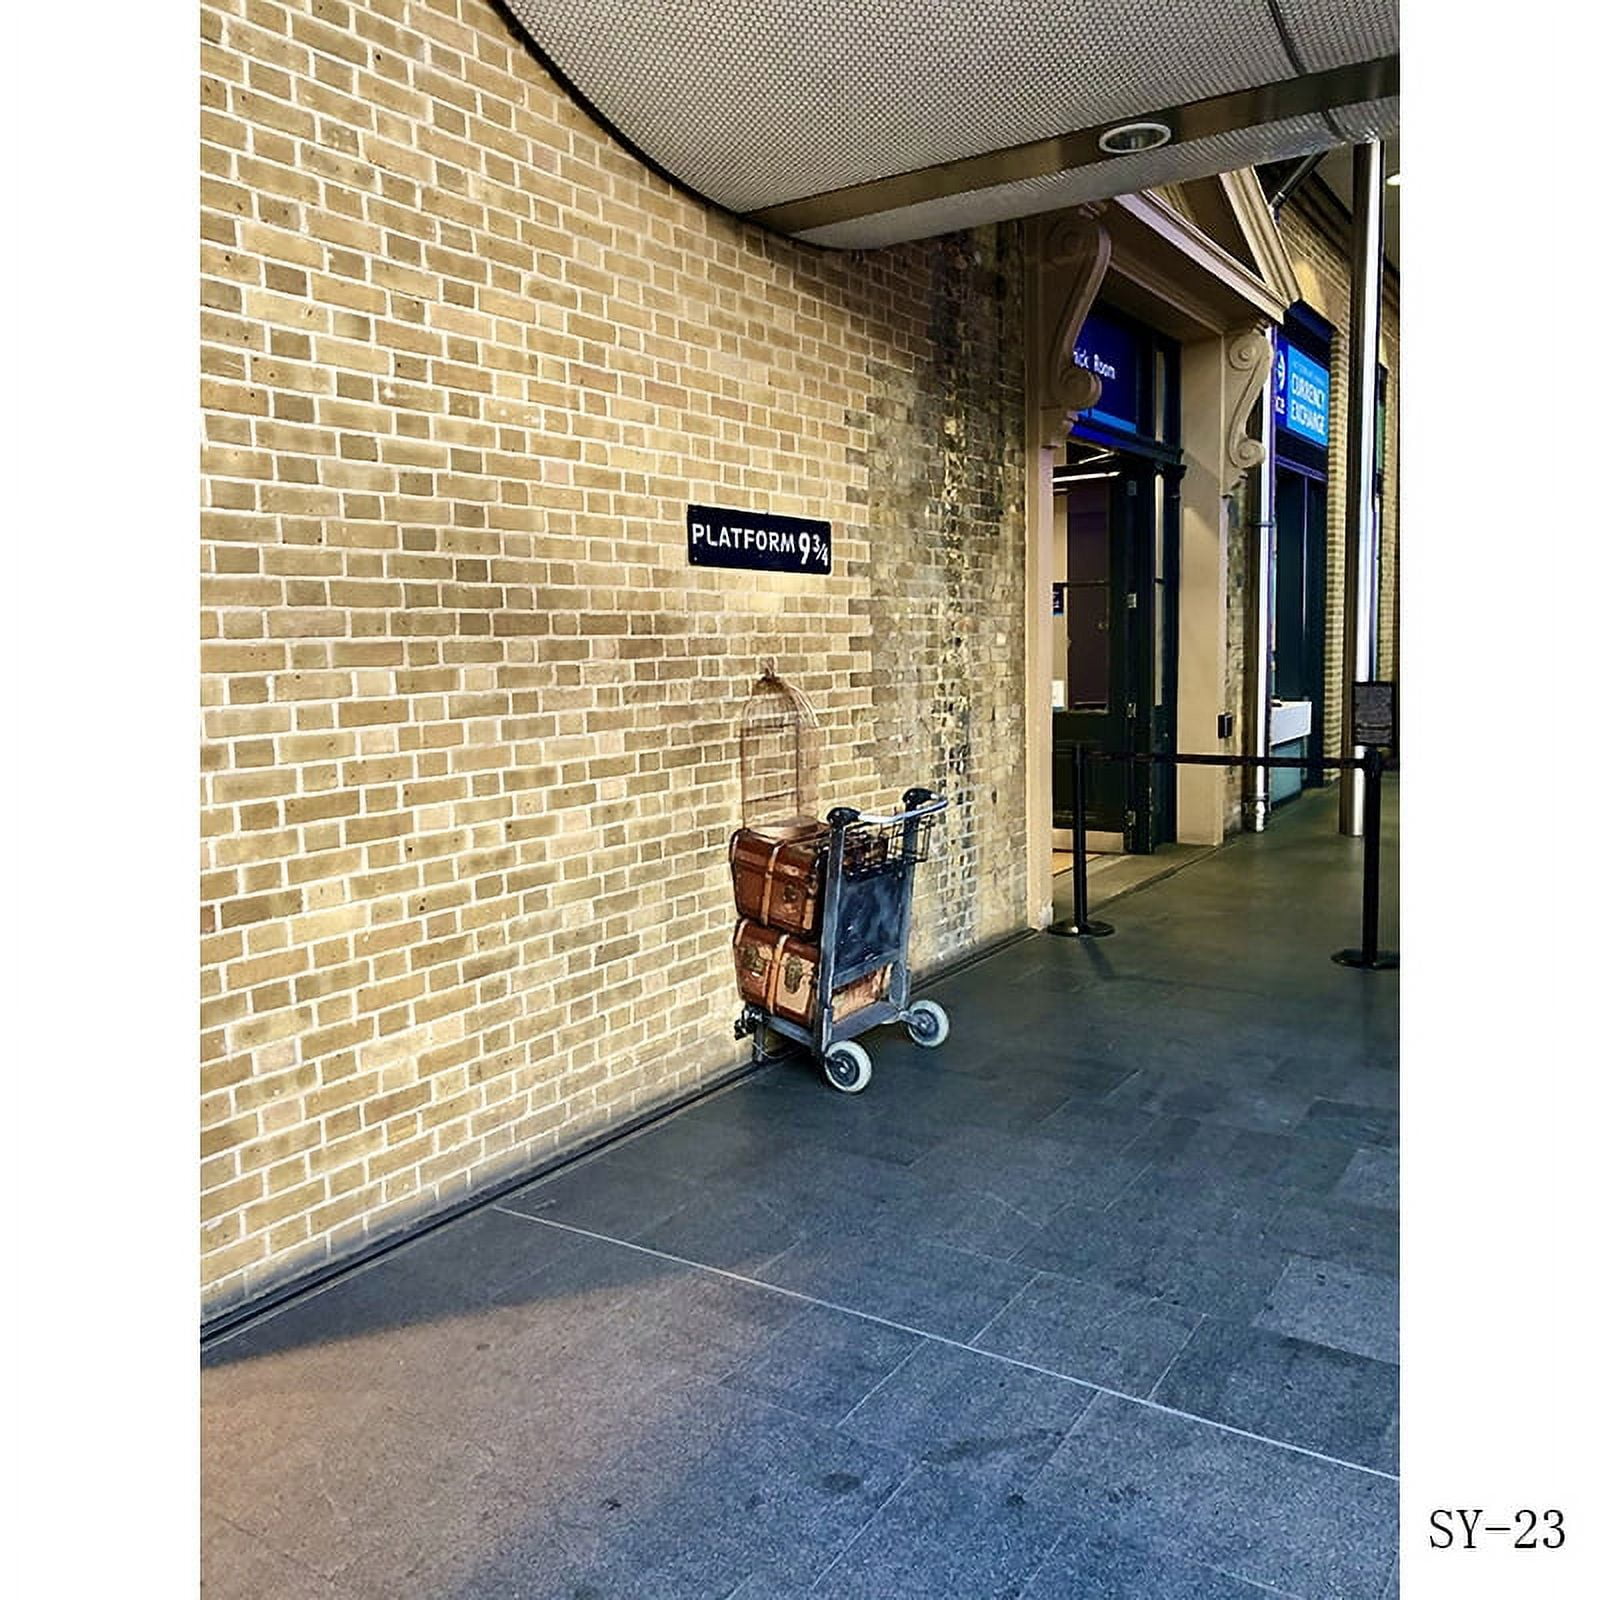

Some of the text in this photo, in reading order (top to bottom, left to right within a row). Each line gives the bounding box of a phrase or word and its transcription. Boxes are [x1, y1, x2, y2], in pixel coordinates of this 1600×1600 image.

[1094, 353, 1116, 379] Room
[1291, 372, 1325, 410] CURRENCY
[1291, 399, 1326, 436] EXCHANGE
[692, 523, 796, 553] PLATFORM
